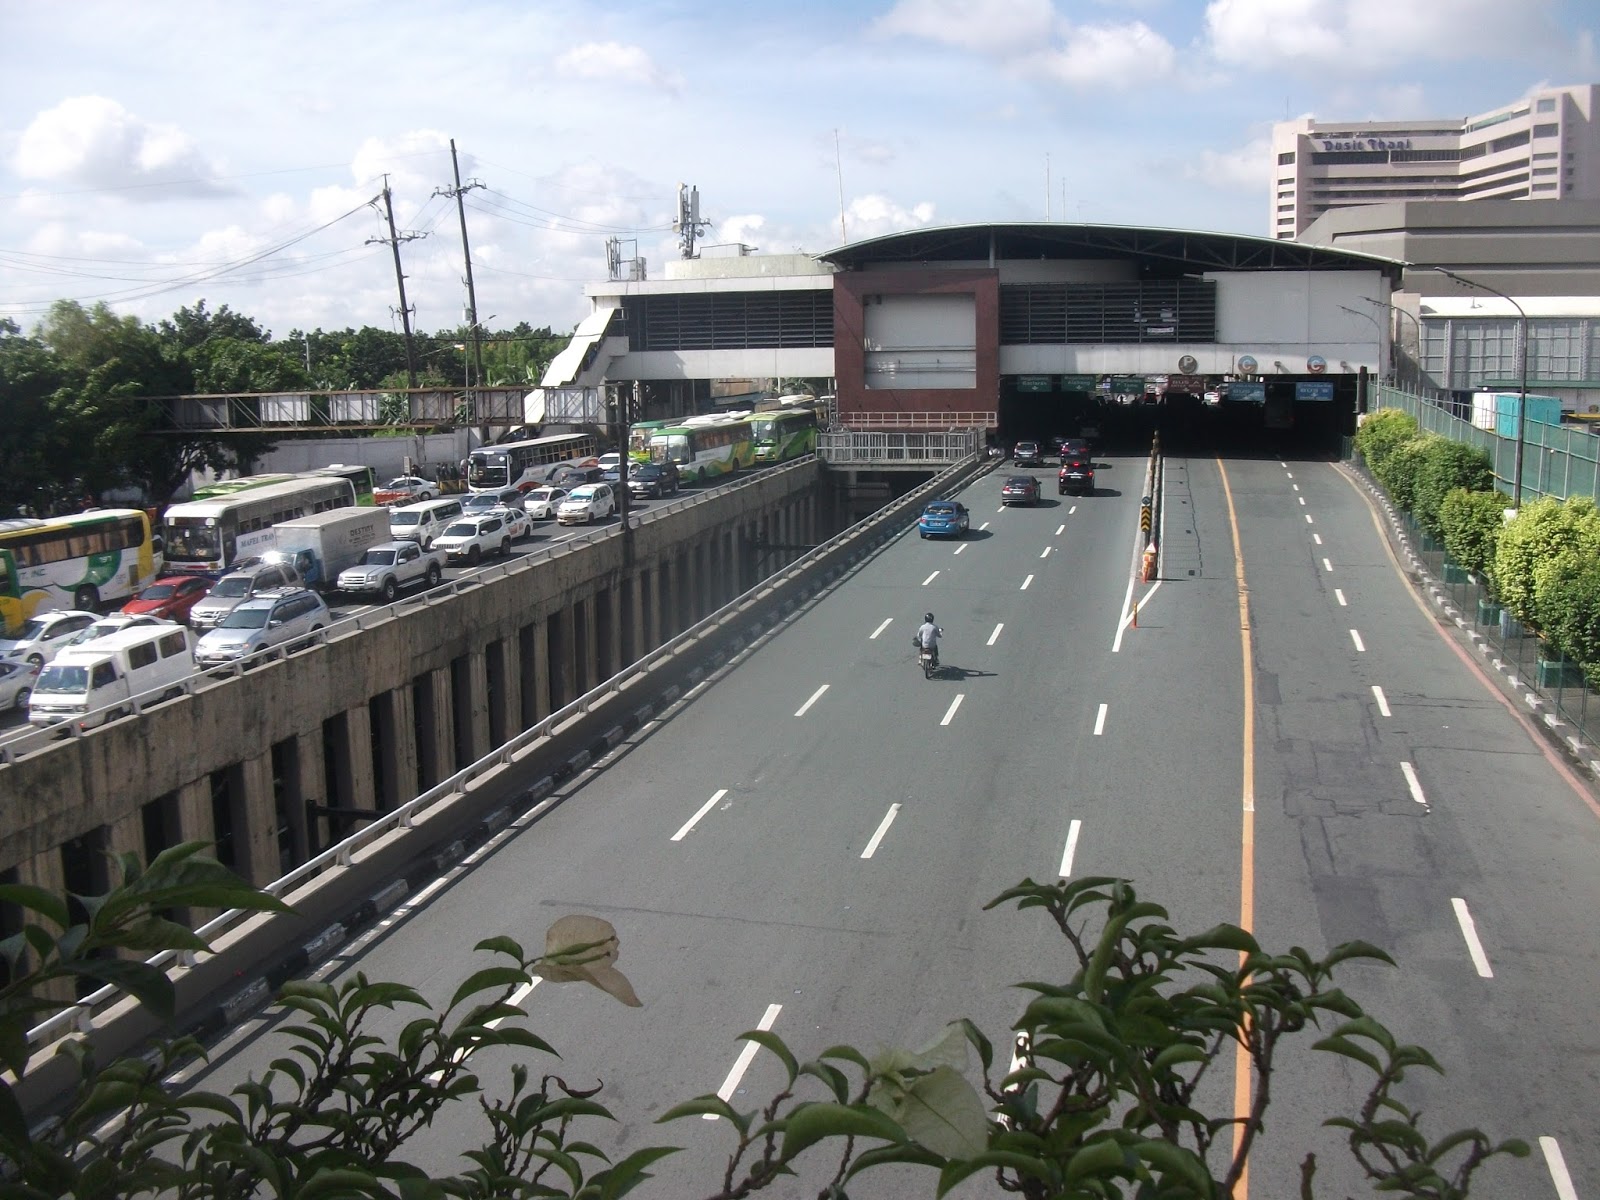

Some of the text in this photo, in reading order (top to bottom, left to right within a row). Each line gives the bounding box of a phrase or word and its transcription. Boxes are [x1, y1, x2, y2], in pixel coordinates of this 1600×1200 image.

[1323, 139, 1410, 151] Dusit Thani
[1183, 356, 1193, 367] P
[350, 524, 373, 536] DESTINY
